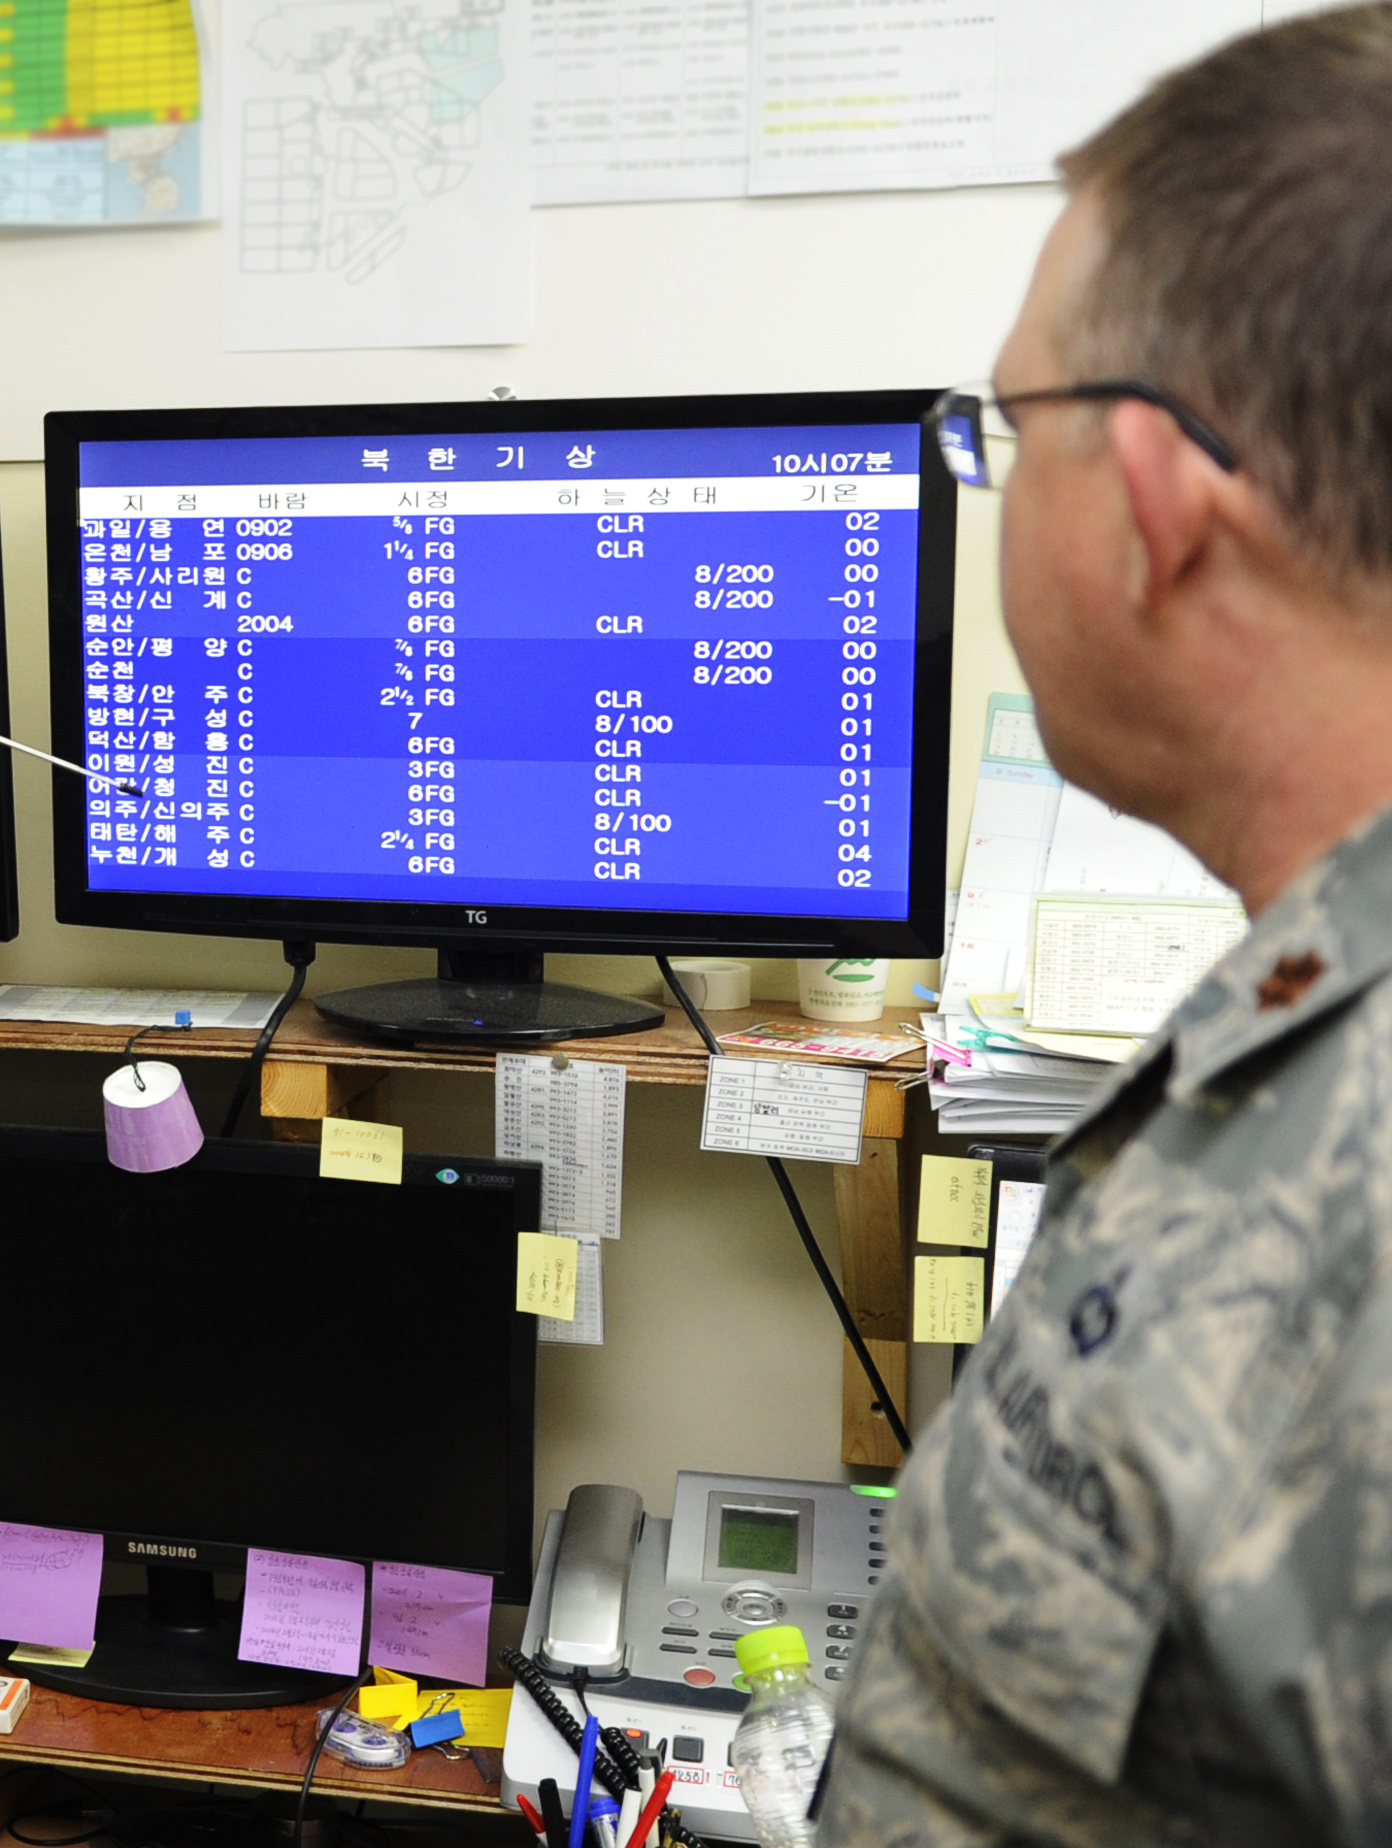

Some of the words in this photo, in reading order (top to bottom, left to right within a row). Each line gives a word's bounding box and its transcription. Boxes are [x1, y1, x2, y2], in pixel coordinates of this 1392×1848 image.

[772, 451, 893, 473] 10시07분
[397, 491, 448, 509] 시정
[801, 484, 859, 503] 기온
[235, 518, 293, 537] 0902
[424, 516, 455, 535] FG
[596, 514, 645, 534] CLR
[845, 511, 880, 531] 02
[236, 542, 293, 561] 0906
[424, 541, 455, 560] FG
[596, 539, 644, 559] CLR
[844, 537, 880, 557] 00
[83, 566, 226, 587] 황주/사리원
[236, 567, 252, 585] C
[694, 562, 775, 585] 8/200
[844, 563, 879, 583] 00
[236, 591, 252, 609] C
[694, 588, 774, 611] 8/200
[827, 589, 875, 609] -01
[84, 613, 135, 633] 원산
[236, 615, 294, 633] 2004
[595, 615, 643, 634] CLR
[842, 615, 878, 635] 02
[237, 638, 253, 657] C
[425, 639, 455, 658] FG
[693, 638, 773, 661] 8/200
[842, 640, 877, 660] 00
[86, 660, 134, 680] 순천
[237, 662, 253, 680] C
[425, 663, 455, 682] FG
[693, 664, 773, 686] 8/200
[841, 666, 877, 686] 00
[237, 686, 253, 704] C
[425, 688, 455, 707] FG
[595, 689, 643, 709] CLR
[841, 692, 873, 711] 01
[238, 710, 254, 728] C
[408, 712, 423, 730] 7
[595, 713, 673, 735] 8/100
[840, 717, 872, 737] 01
[238, 733, 254, 751] C
[594, 739, 642, 758] CLR
[840, 742, 871, 762] 01
[238, 757, 254, 775] C
[594, 763, 642, 783] CLR
[839, 768, 871, 787] 01
[238, 780, 255, 798] C
[594, 788, 642, 807] CLR
[823, 793, 870, 812] -01
[88, 799, 230, 822] 의주/신의주
[238, 803, 255, 822] C
[594, 811, 672, 833] 8/100
[838, 818, 870, 838] 01
[239, 827, 255, 845] C
[425, 832, 455, 851] FG
[594, 837, 641, 856] CLR
[837, 843, 873, 863] 04
[239, 850, 255, 868] C
[593, 861, 641, 880] CLR
[837, 868, 872, 888] 02
[465, 910, 488, 924] TG
[128, 1541, 197, 1559] SAMSUNG
